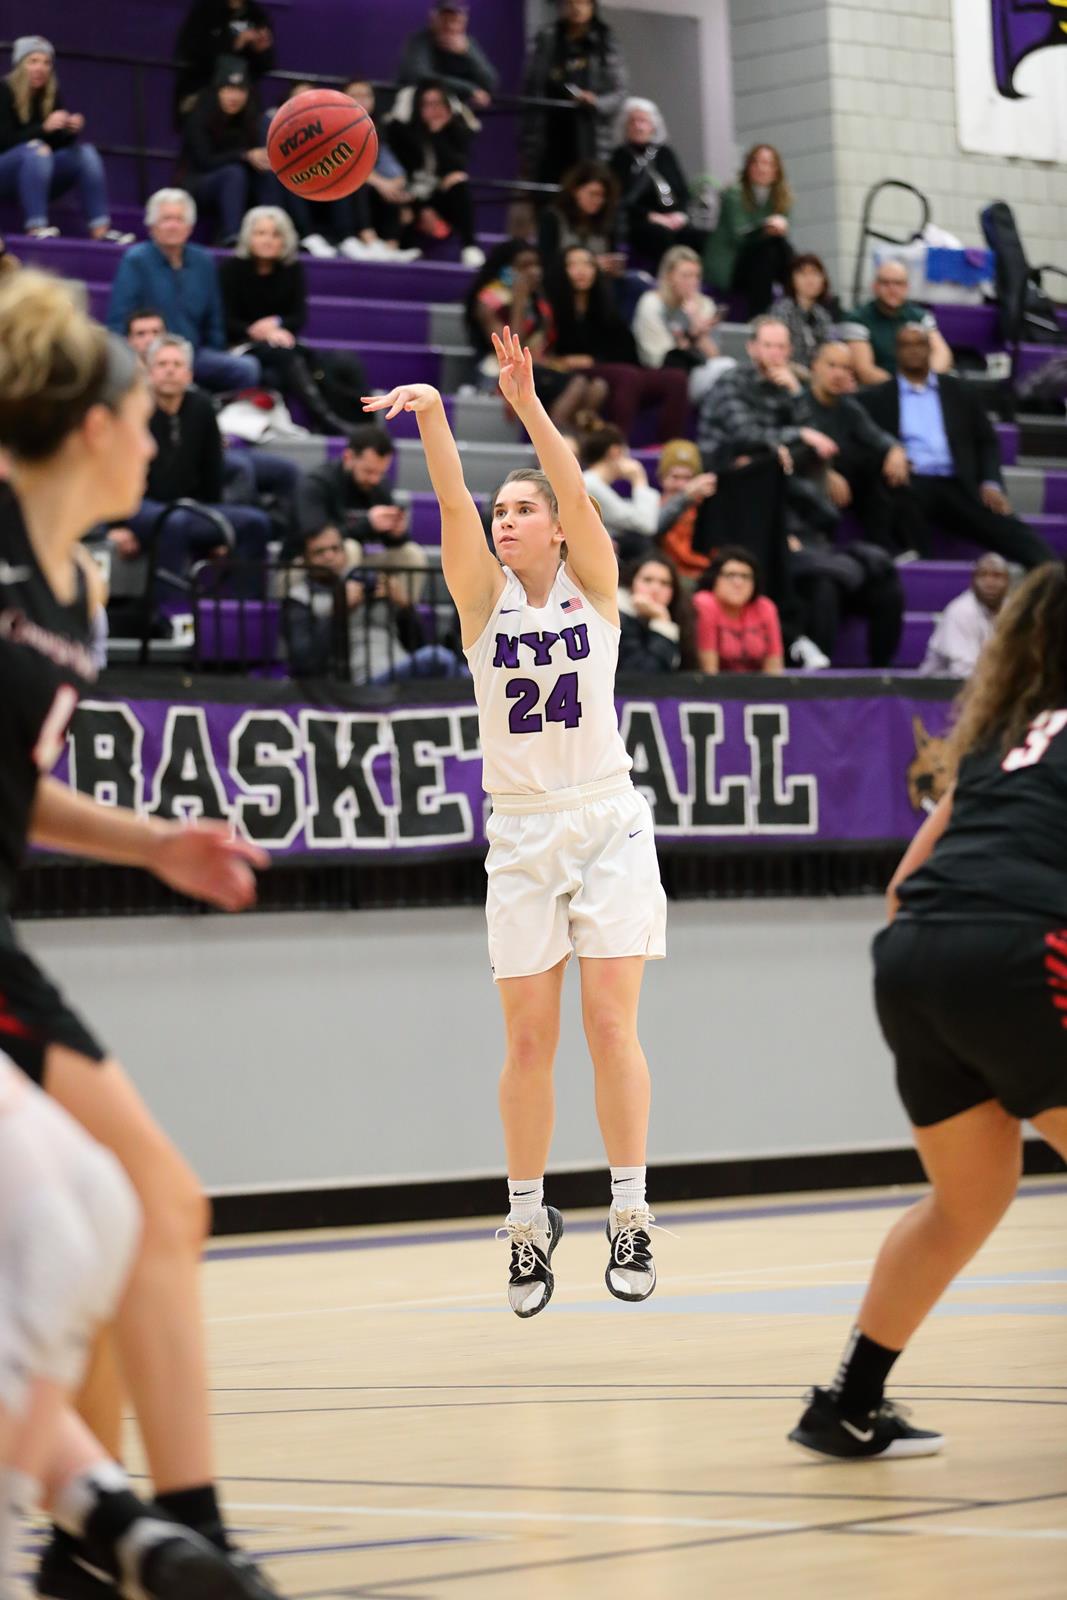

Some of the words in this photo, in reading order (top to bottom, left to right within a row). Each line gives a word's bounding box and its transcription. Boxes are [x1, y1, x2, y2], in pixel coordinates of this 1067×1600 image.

[279, 120, 324, 158] NCAA
[290, 141, 355, 185] Wilson
[493, 623, 590, 668] NYU
[506, 672, 582, 734] 24
[69, 699, 819, 848] BASKEALL
